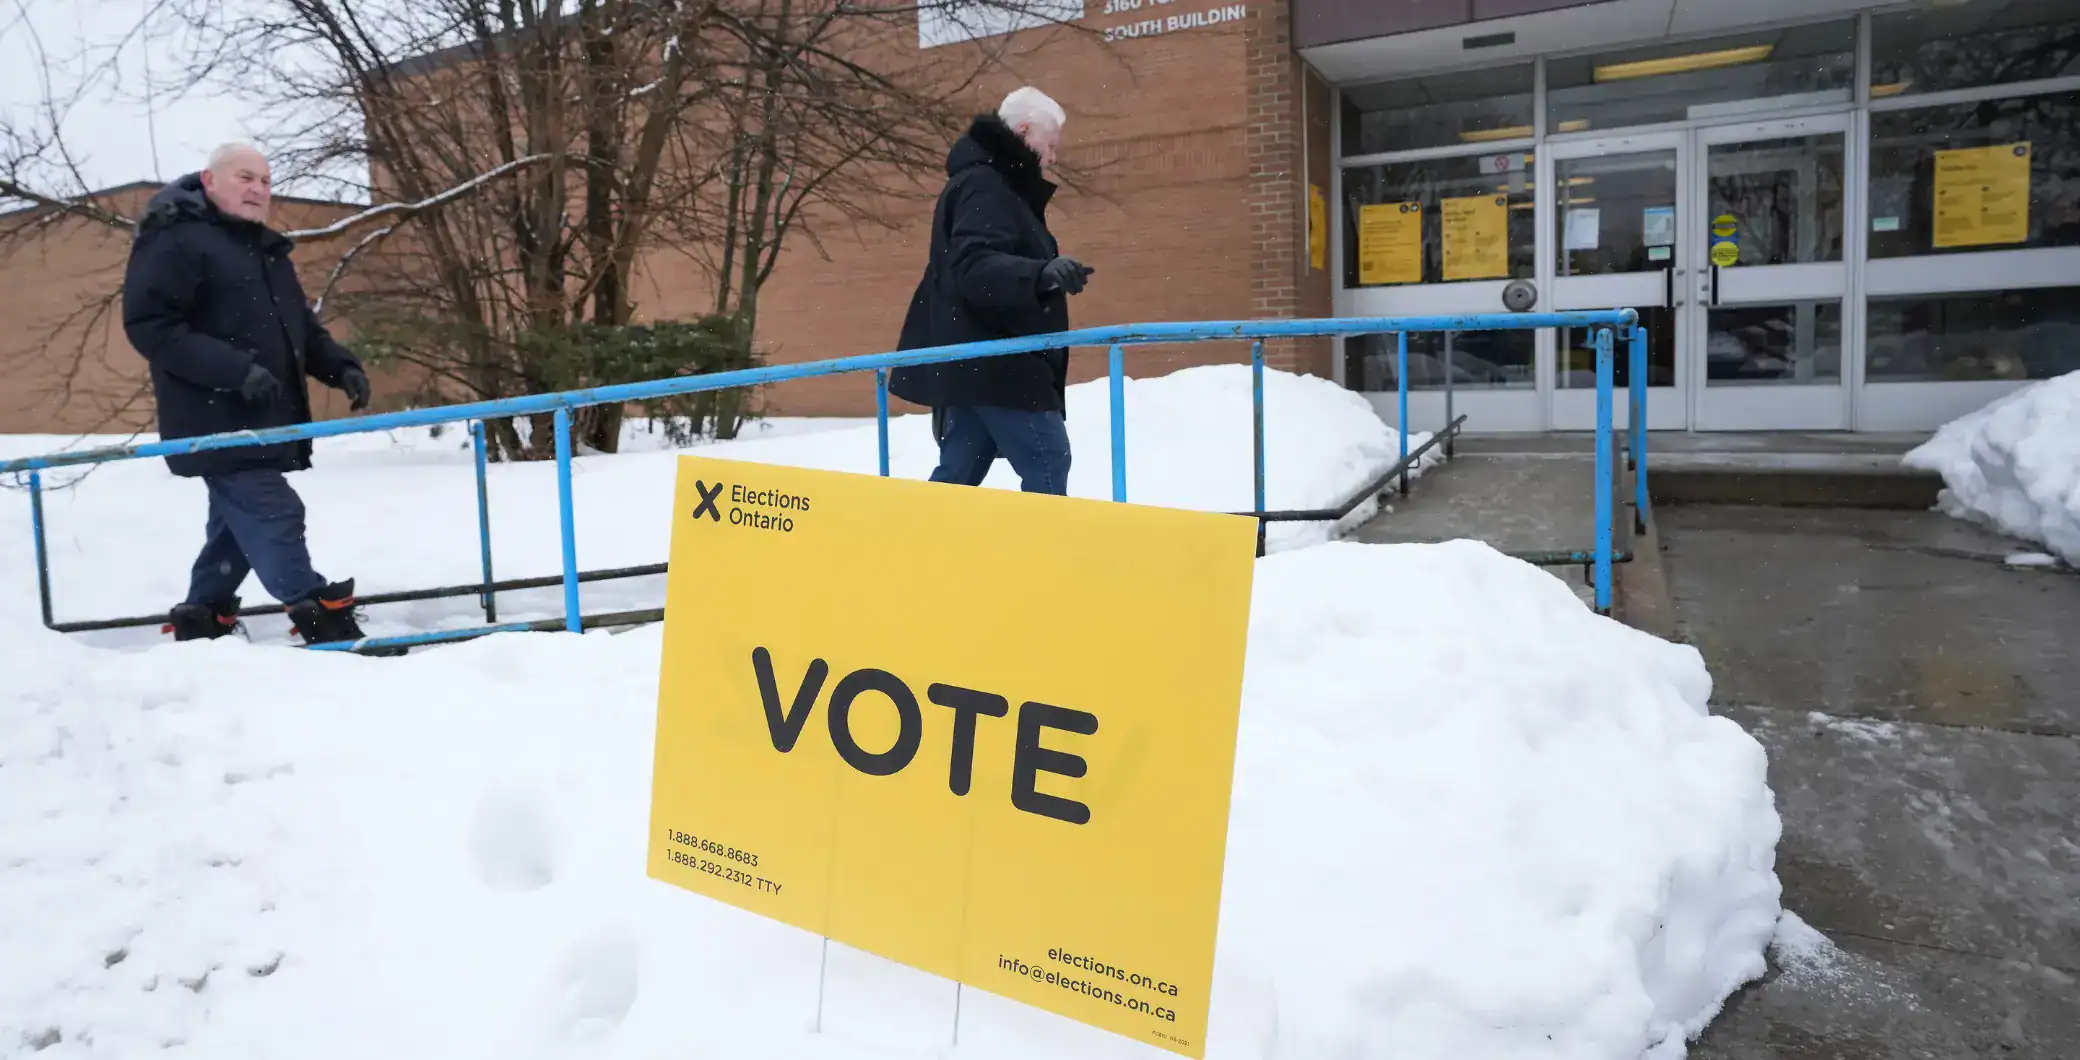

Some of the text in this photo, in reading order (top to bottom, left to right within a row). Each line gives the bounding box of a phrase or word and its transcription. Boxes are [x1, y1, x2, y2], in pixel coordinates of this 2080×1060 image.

[1104, 19, 1162, 43] SOUTH
[729, 506, 794, 533] Ontario
[731, 484, 811, 512] Elections
[752, 646, 1099, 825] VOTE
[668, 828, 759, 867] 1.888.668.8683
[666, 848, 782, 896] 1.888.292.2312 TTY
[998, 954, 1176, 1022] info@elections.on.ca
[1047, 947, 1179, 997] elections.on.ca
